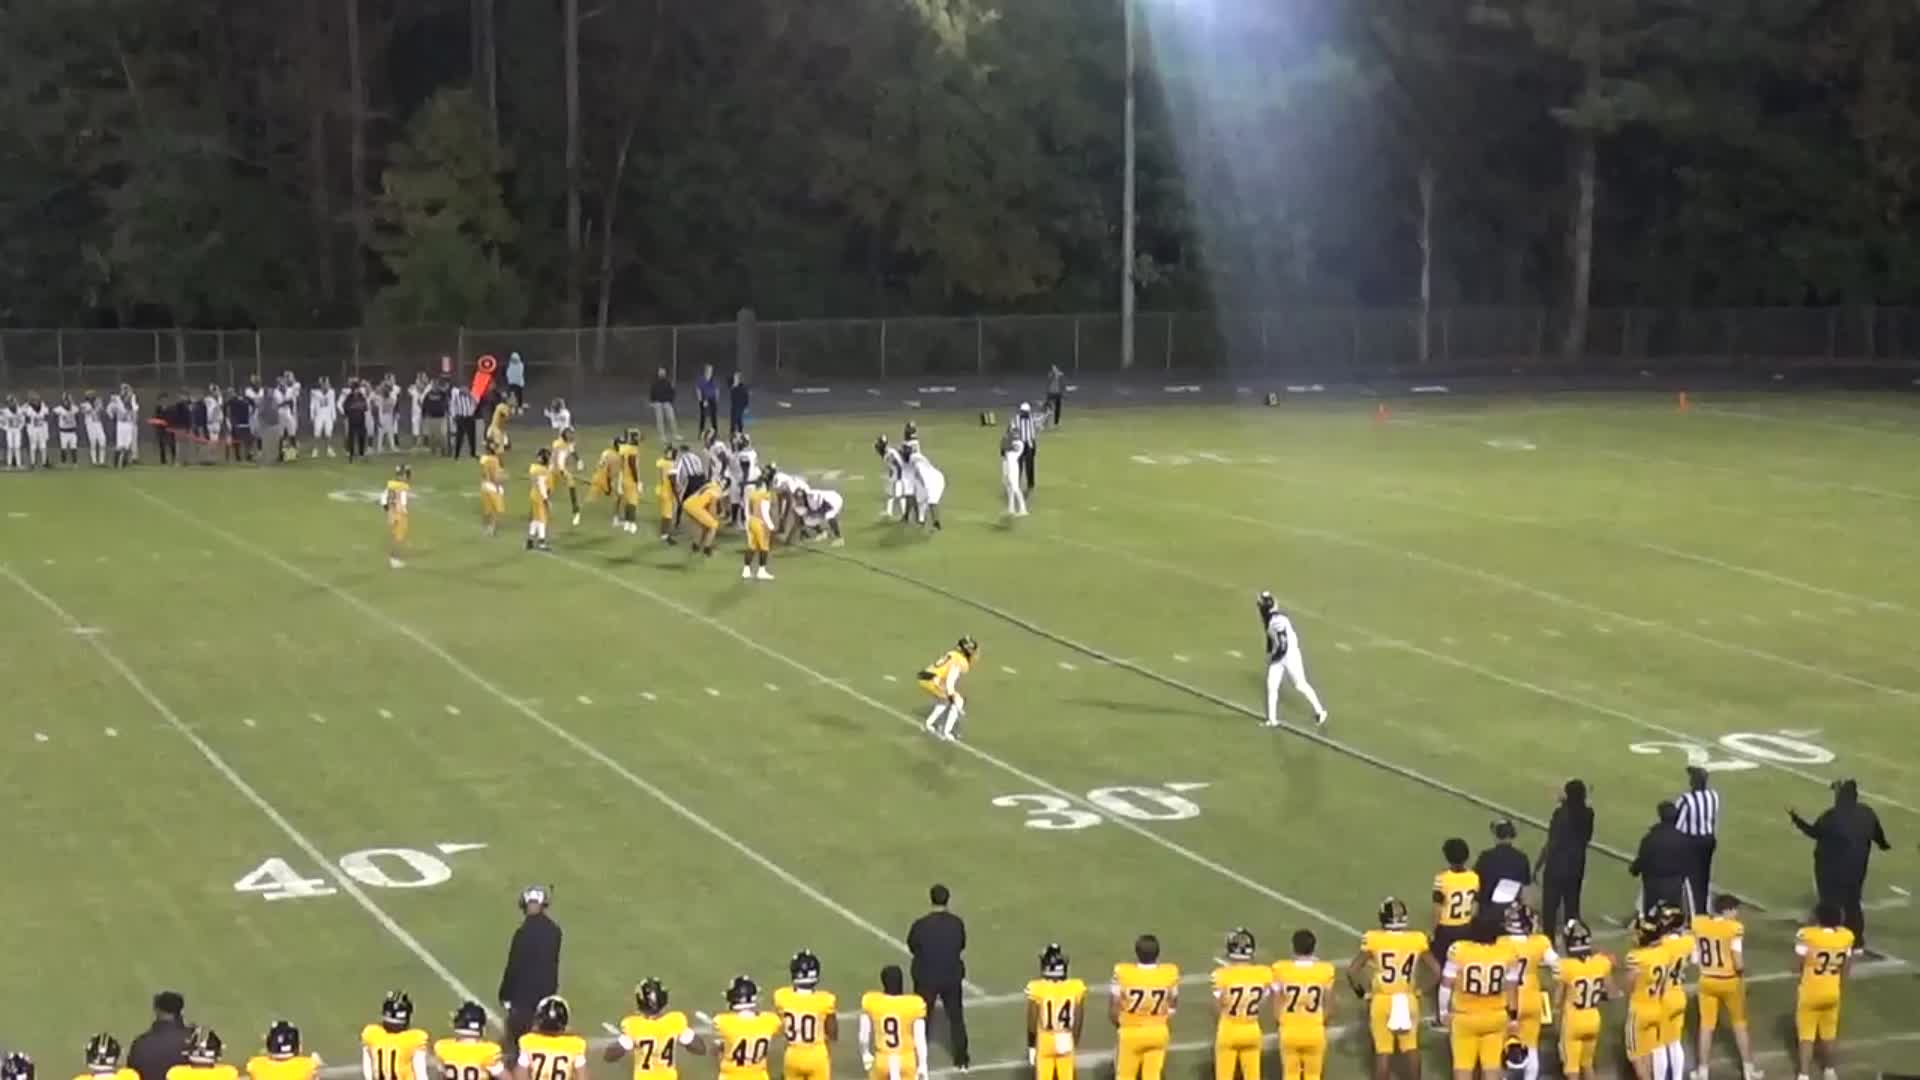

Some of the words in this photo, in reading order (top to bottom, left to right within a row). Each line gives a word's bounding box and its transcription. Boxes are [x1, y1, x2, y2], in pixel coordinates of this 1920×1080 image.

[1629, 732, 1835, 771] 20
[991, 785, 1201, 830] 30
[233, 848, 452, 900] 40
[1699, 937, 1725, 967] 81
[1381, 953, 1415, 983] 54
[1466, 965, 1505, 995] 68
[1045, 999, 1072, 1031] 14
[1128, 989, 1165, 1016] 77
[1229, 986, 1262, 1017] 72
[1286, 985, 1321, 1014] 73
[784, 1012, 815, 1043] 30
[884, 1016, 899, 1048] 9
[377, 1048, 397, 1080] 11
[531, 1052, 569, 1080] 76
[639, 1038, 675, 1070] 74
[732, 1038, 769, 1067] 40
